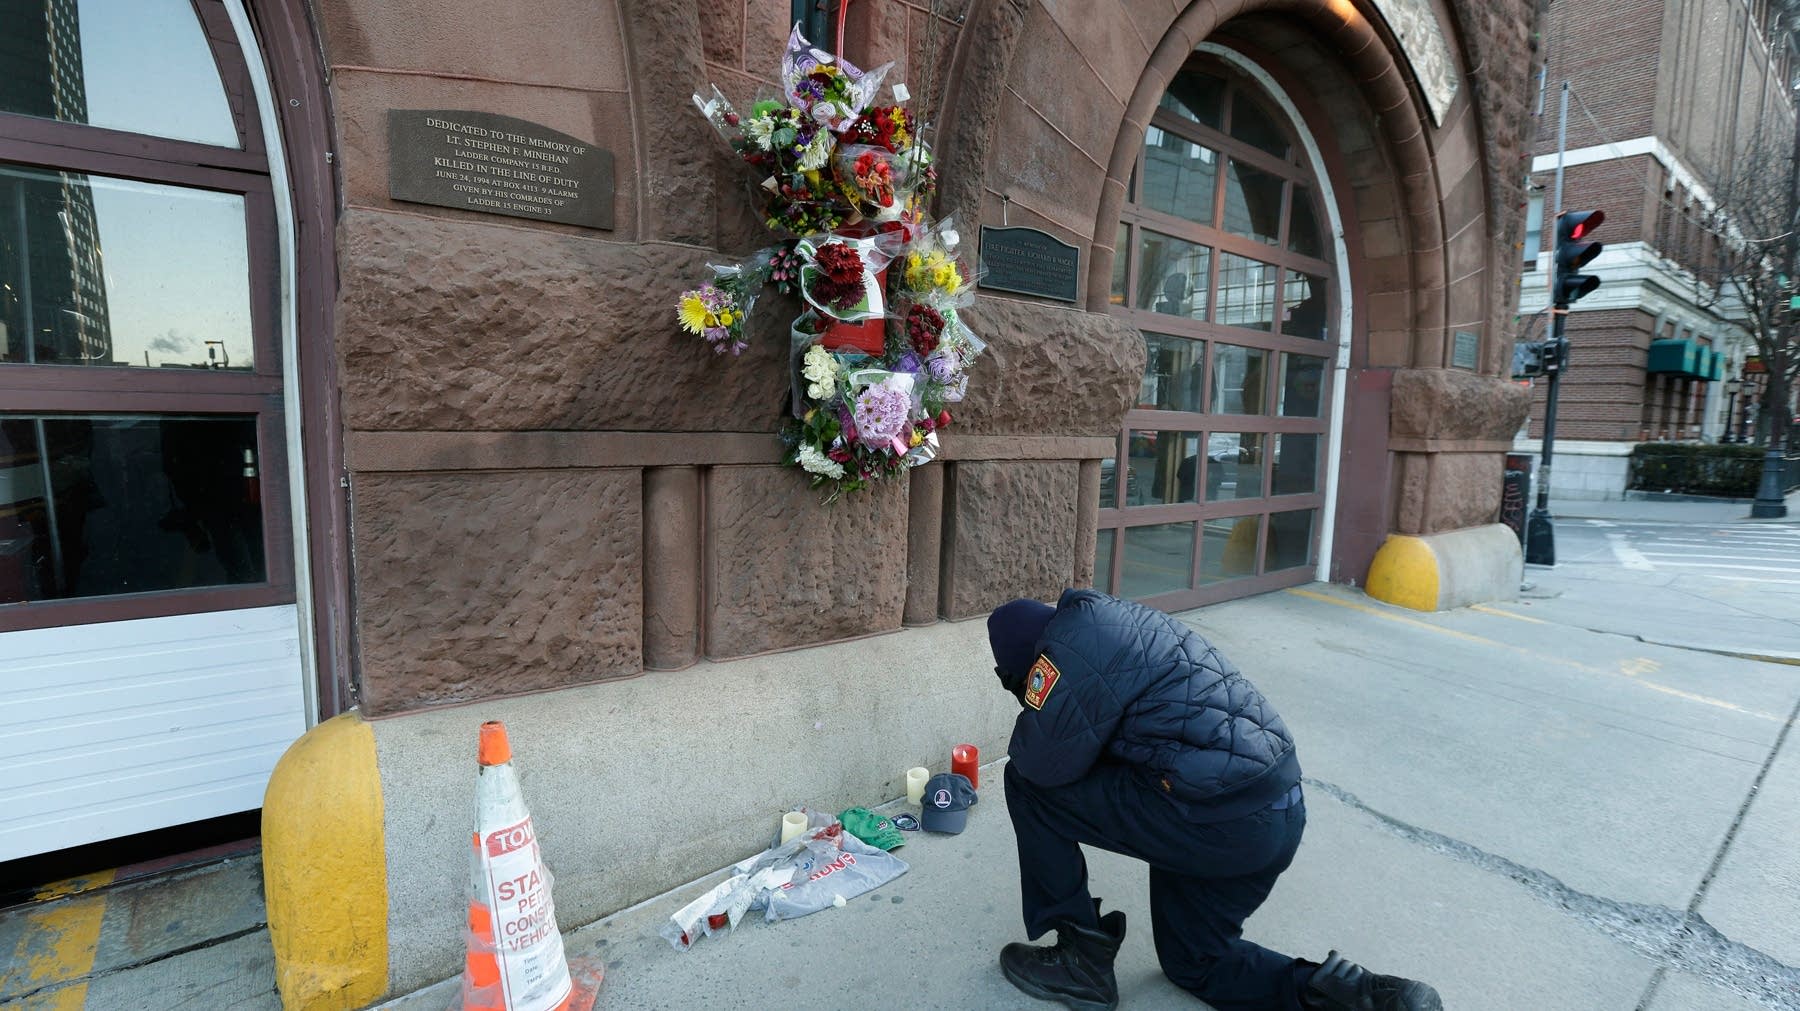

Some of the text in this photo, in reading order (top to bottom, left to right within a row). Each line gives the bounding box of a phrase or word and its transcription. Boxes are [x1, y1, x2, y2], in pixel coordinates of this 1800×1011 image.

[426, 117, 586, 155] DEDICATED TO THE MEMORY OF
[446, 135, 569, 165] LT. STEPHEN F. MINEHAN
[434, 156, 579, 189] KILLED IN THE LINE OF DUTY
[455, 149, 489, 162] LADDER
[490, 155, 530, 169] COMPANY
[436, 170, 458, 180] JUNE
[473, 176, 490, 184] 1994
[503, 181, 520, 190] BOX
[548, 188, 579, 199] ALARMS
[453, 183, 565, 207] GIVEN BY HIS COMRADES OF
[467, 197, 501, 208] LADDER
[513, 203, 542, 214] ENGINE
[498, 869, 543, 901] STA
